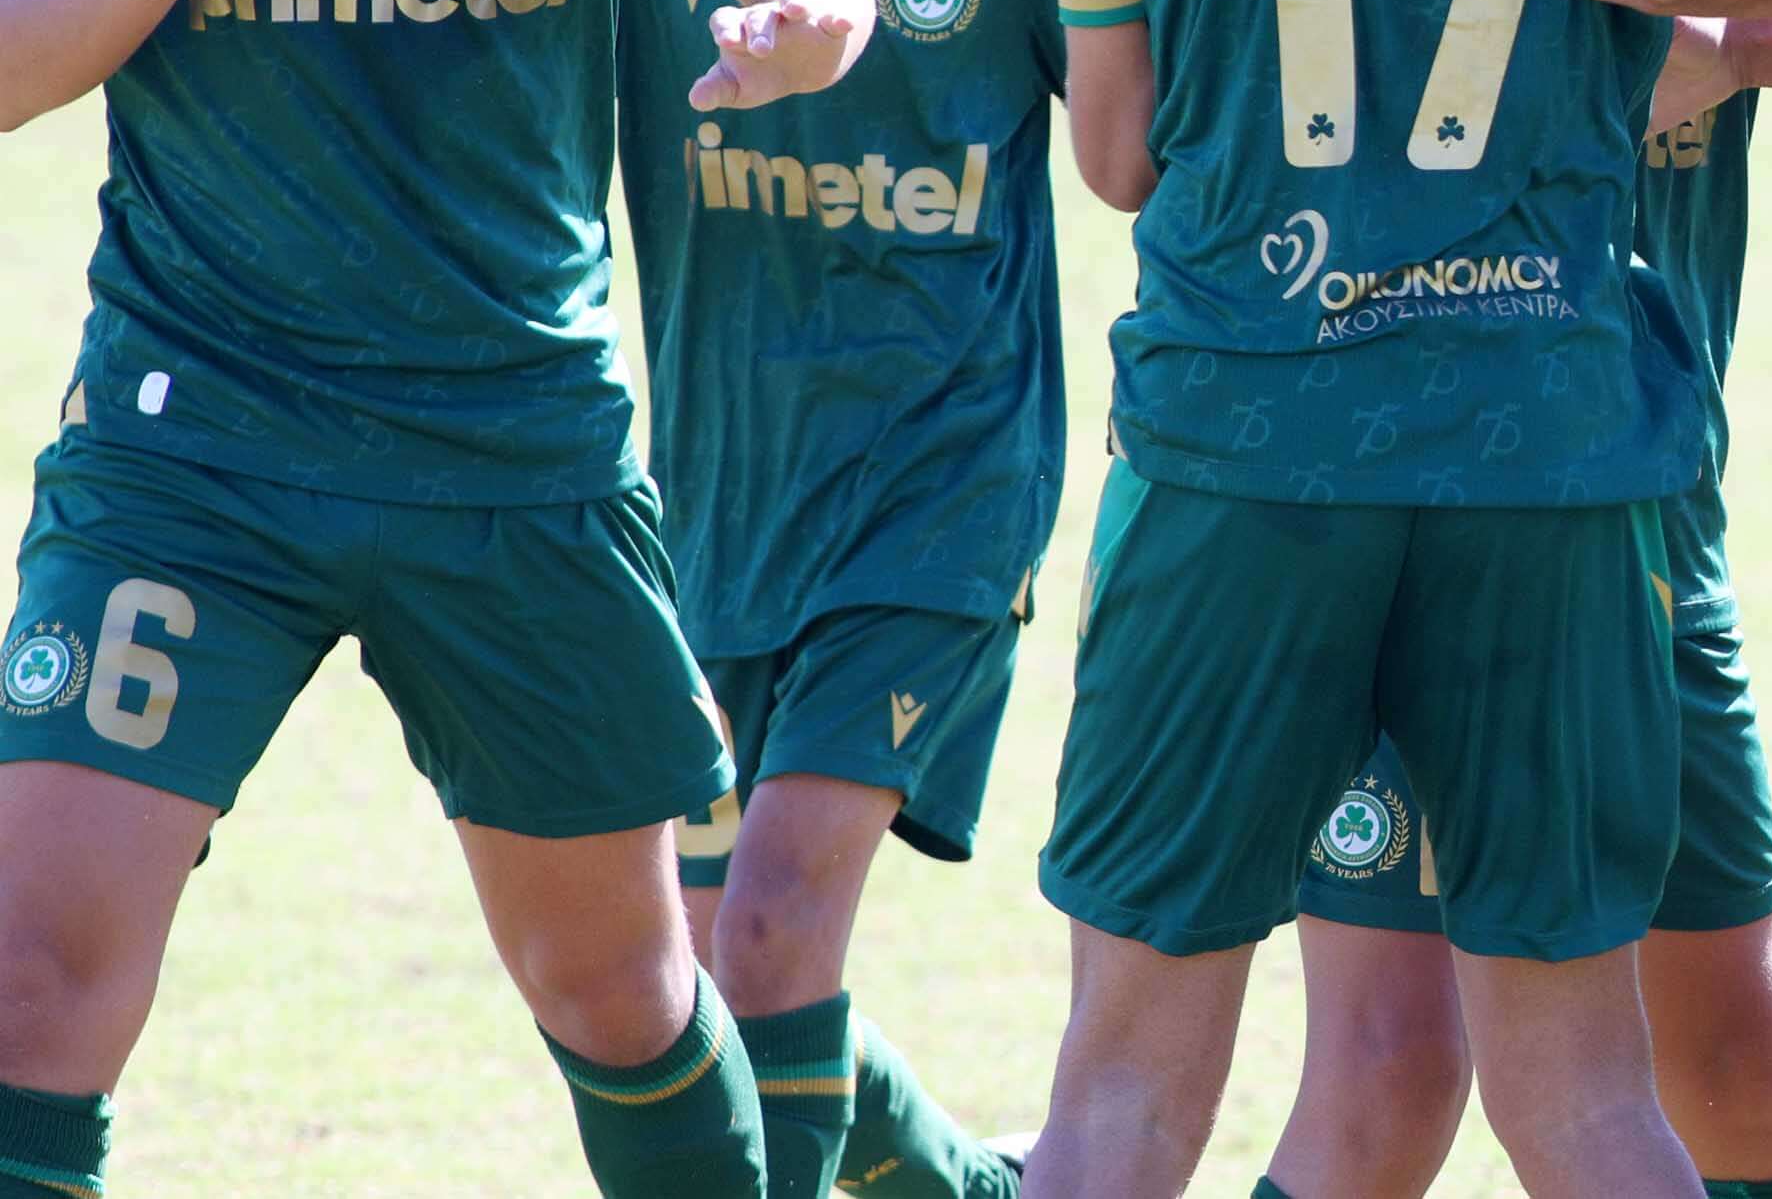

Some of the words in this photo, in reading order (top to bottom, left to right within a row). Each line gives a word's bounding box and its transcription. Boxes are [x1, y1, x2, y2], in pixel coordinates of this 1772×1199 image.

[684, 121, 988, 235] imetel
[85, 577, 197, 750] 6
[1337, 867, 1374, 879] YEARS
